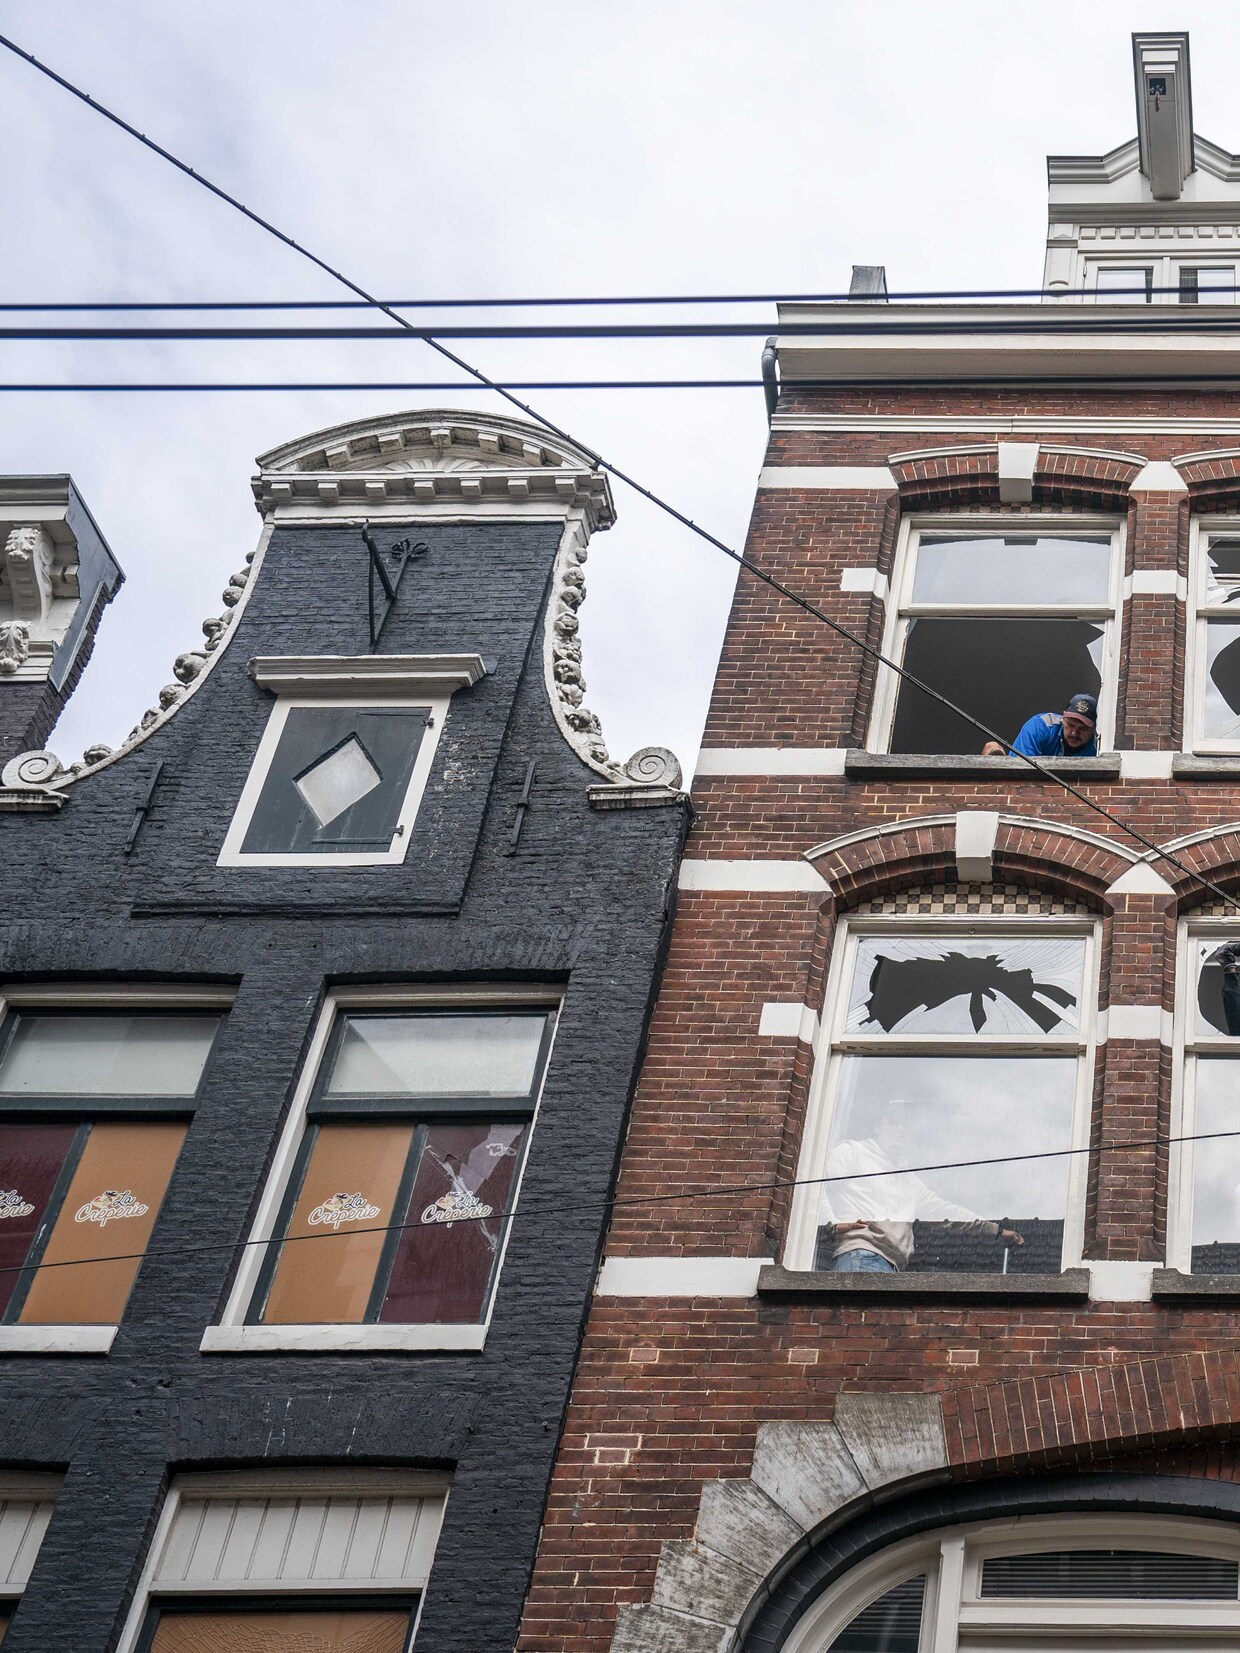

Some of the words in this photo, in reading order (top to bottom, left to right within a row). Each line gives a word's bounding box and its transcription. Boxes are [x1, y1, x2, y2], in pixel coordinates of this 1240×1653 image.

[112, 1190, 136, 1207] La
[343, 1192, 367, 1209] La
[455, 1191, 479, 1207] La
